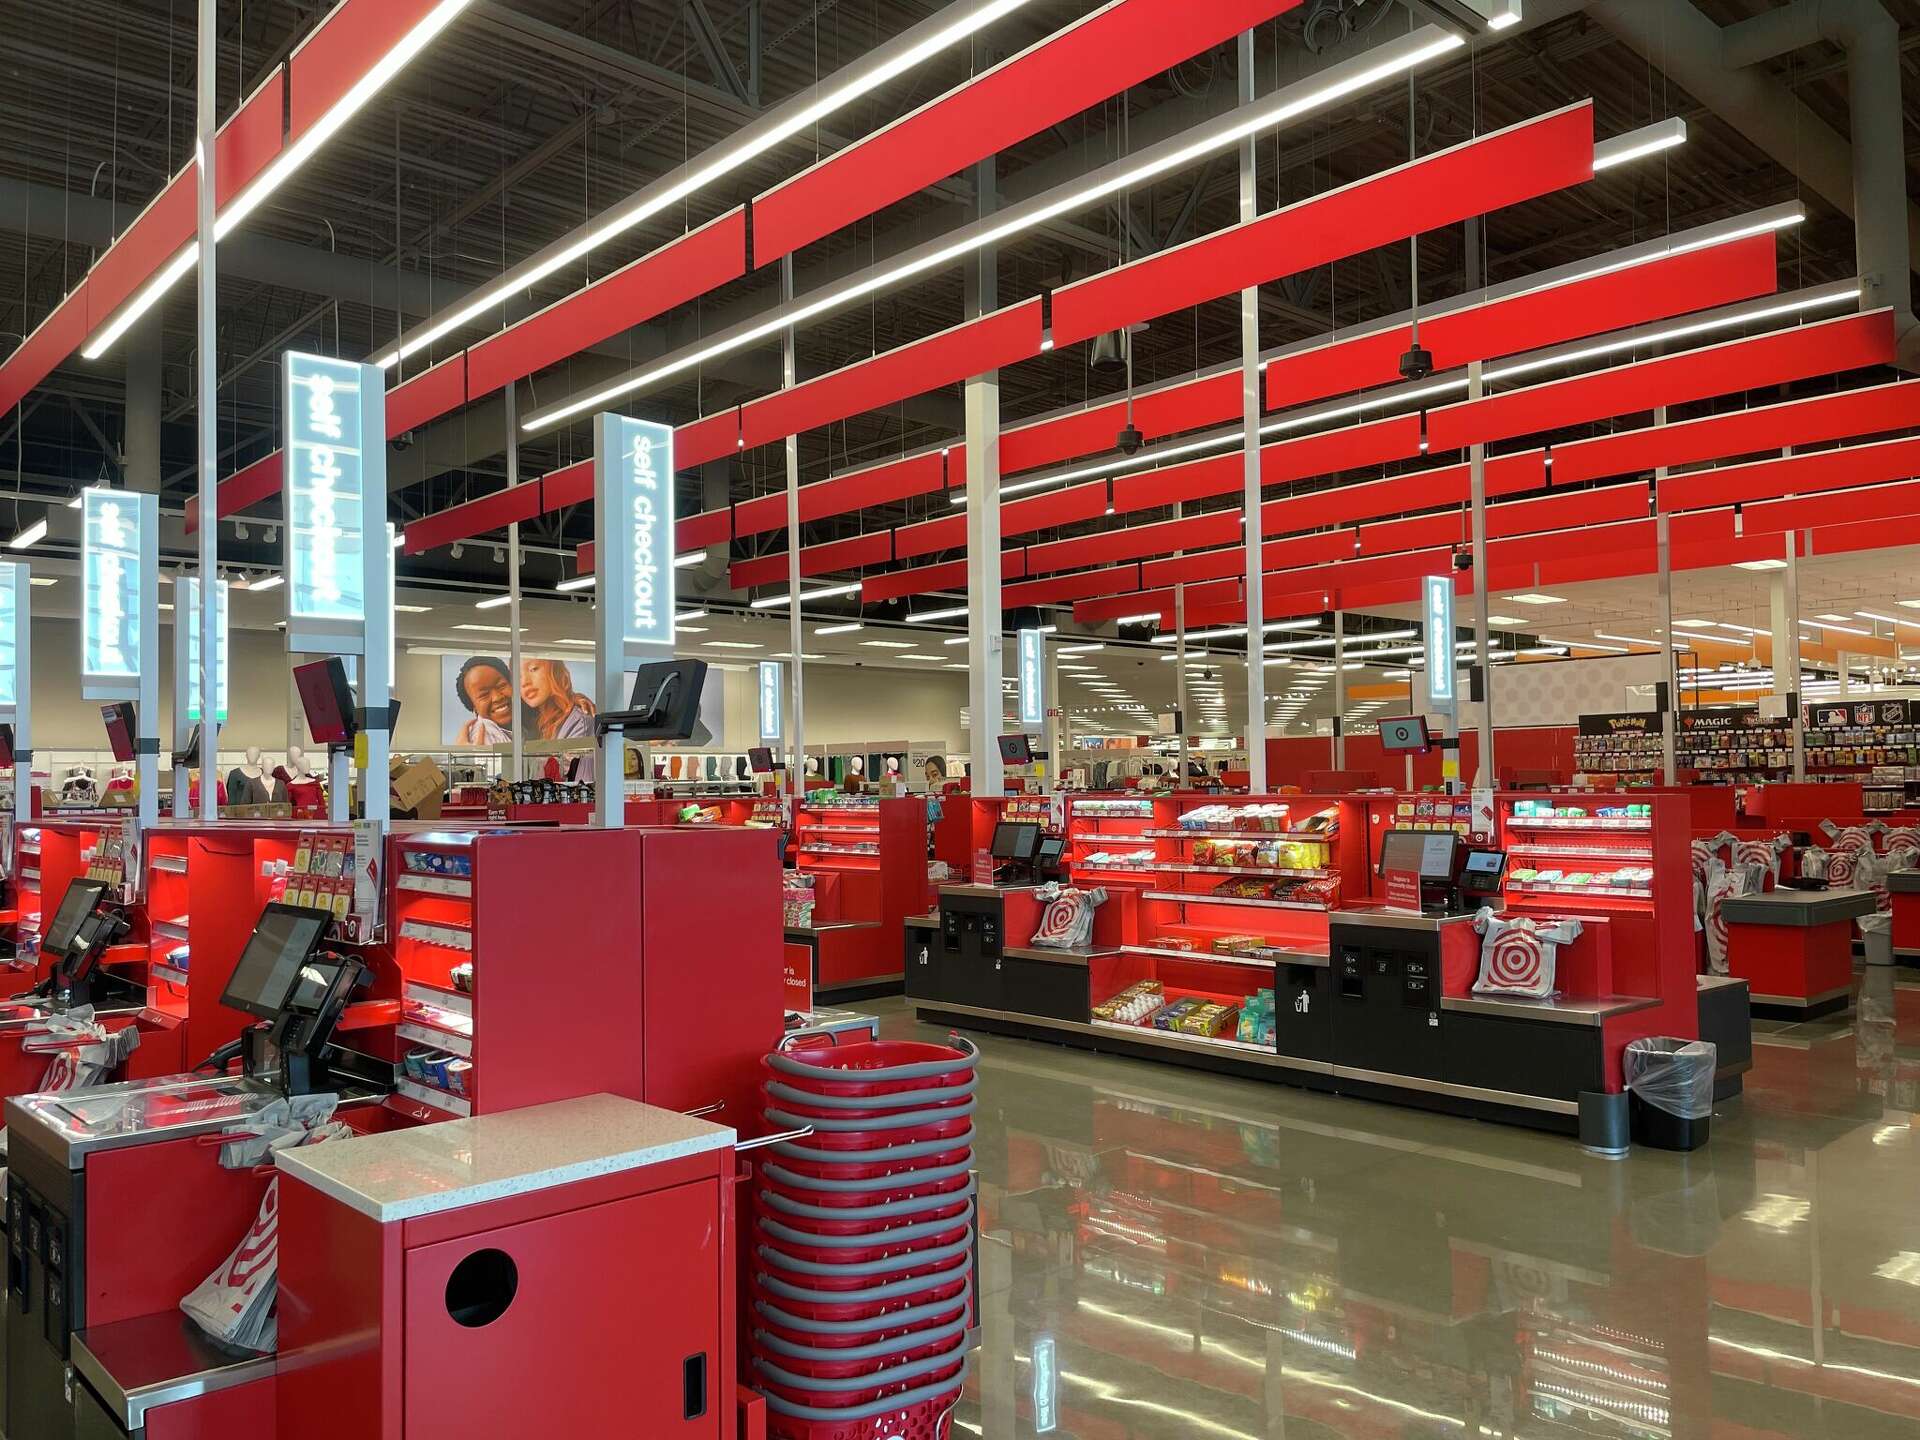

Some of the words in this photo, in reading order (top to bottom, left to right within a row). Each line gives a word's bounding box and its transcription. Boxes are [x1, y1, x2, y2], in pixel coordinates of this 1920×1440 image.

[309, 373, 342, 440] self
[632, 434, 658, 490] self
[309, 444, 342, 603] checkout
[632, 494, 658, 629] checkout
[1694, 717, 1733, 726] MAGIC
[1856, 714, 1872, 723] NFL
[786, 977, 807, 987] closed
